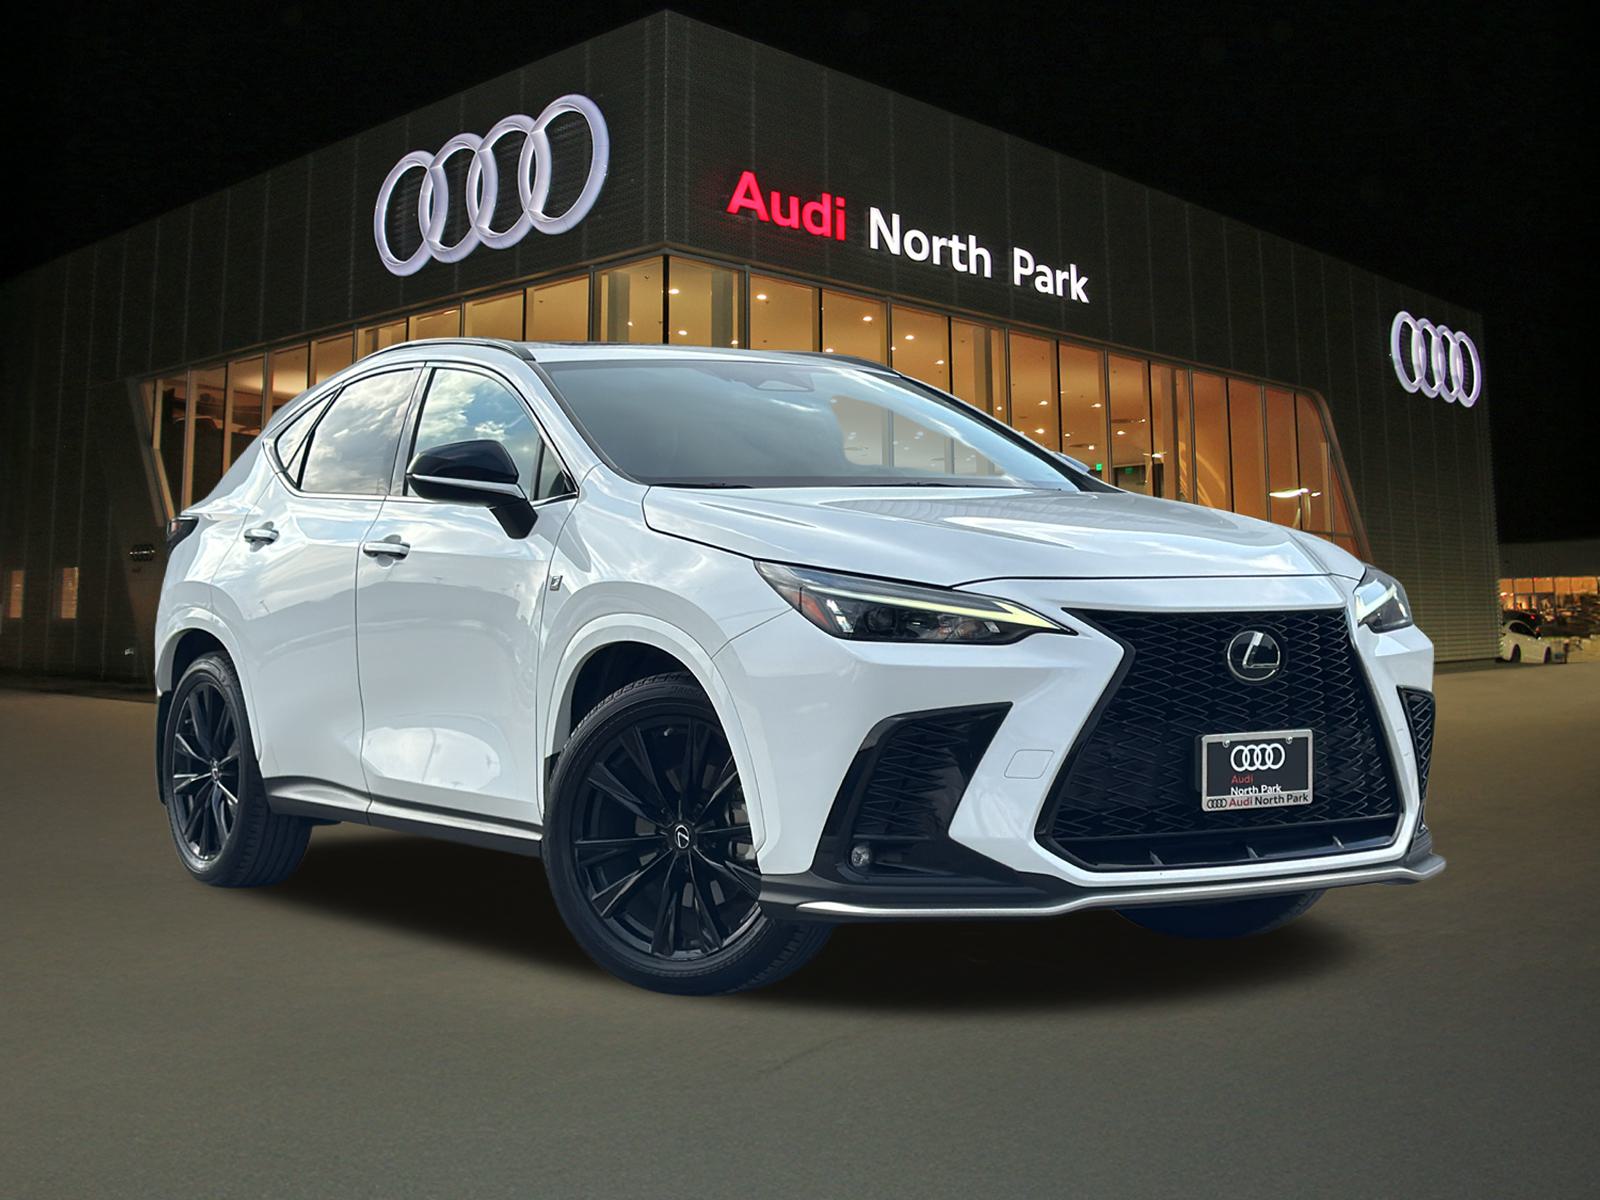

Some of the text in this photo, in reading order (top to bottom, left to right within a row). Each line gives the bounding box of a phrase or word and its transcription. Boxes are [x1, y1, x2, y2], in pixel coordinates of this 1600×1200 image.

[726, 170, 1090, 304] Audi North Park
[1231, 774, 1254, 784] Audi
[1230, 783, 1282, 796] North Park
[1229, 793, 1309, 808] Audi North Park
